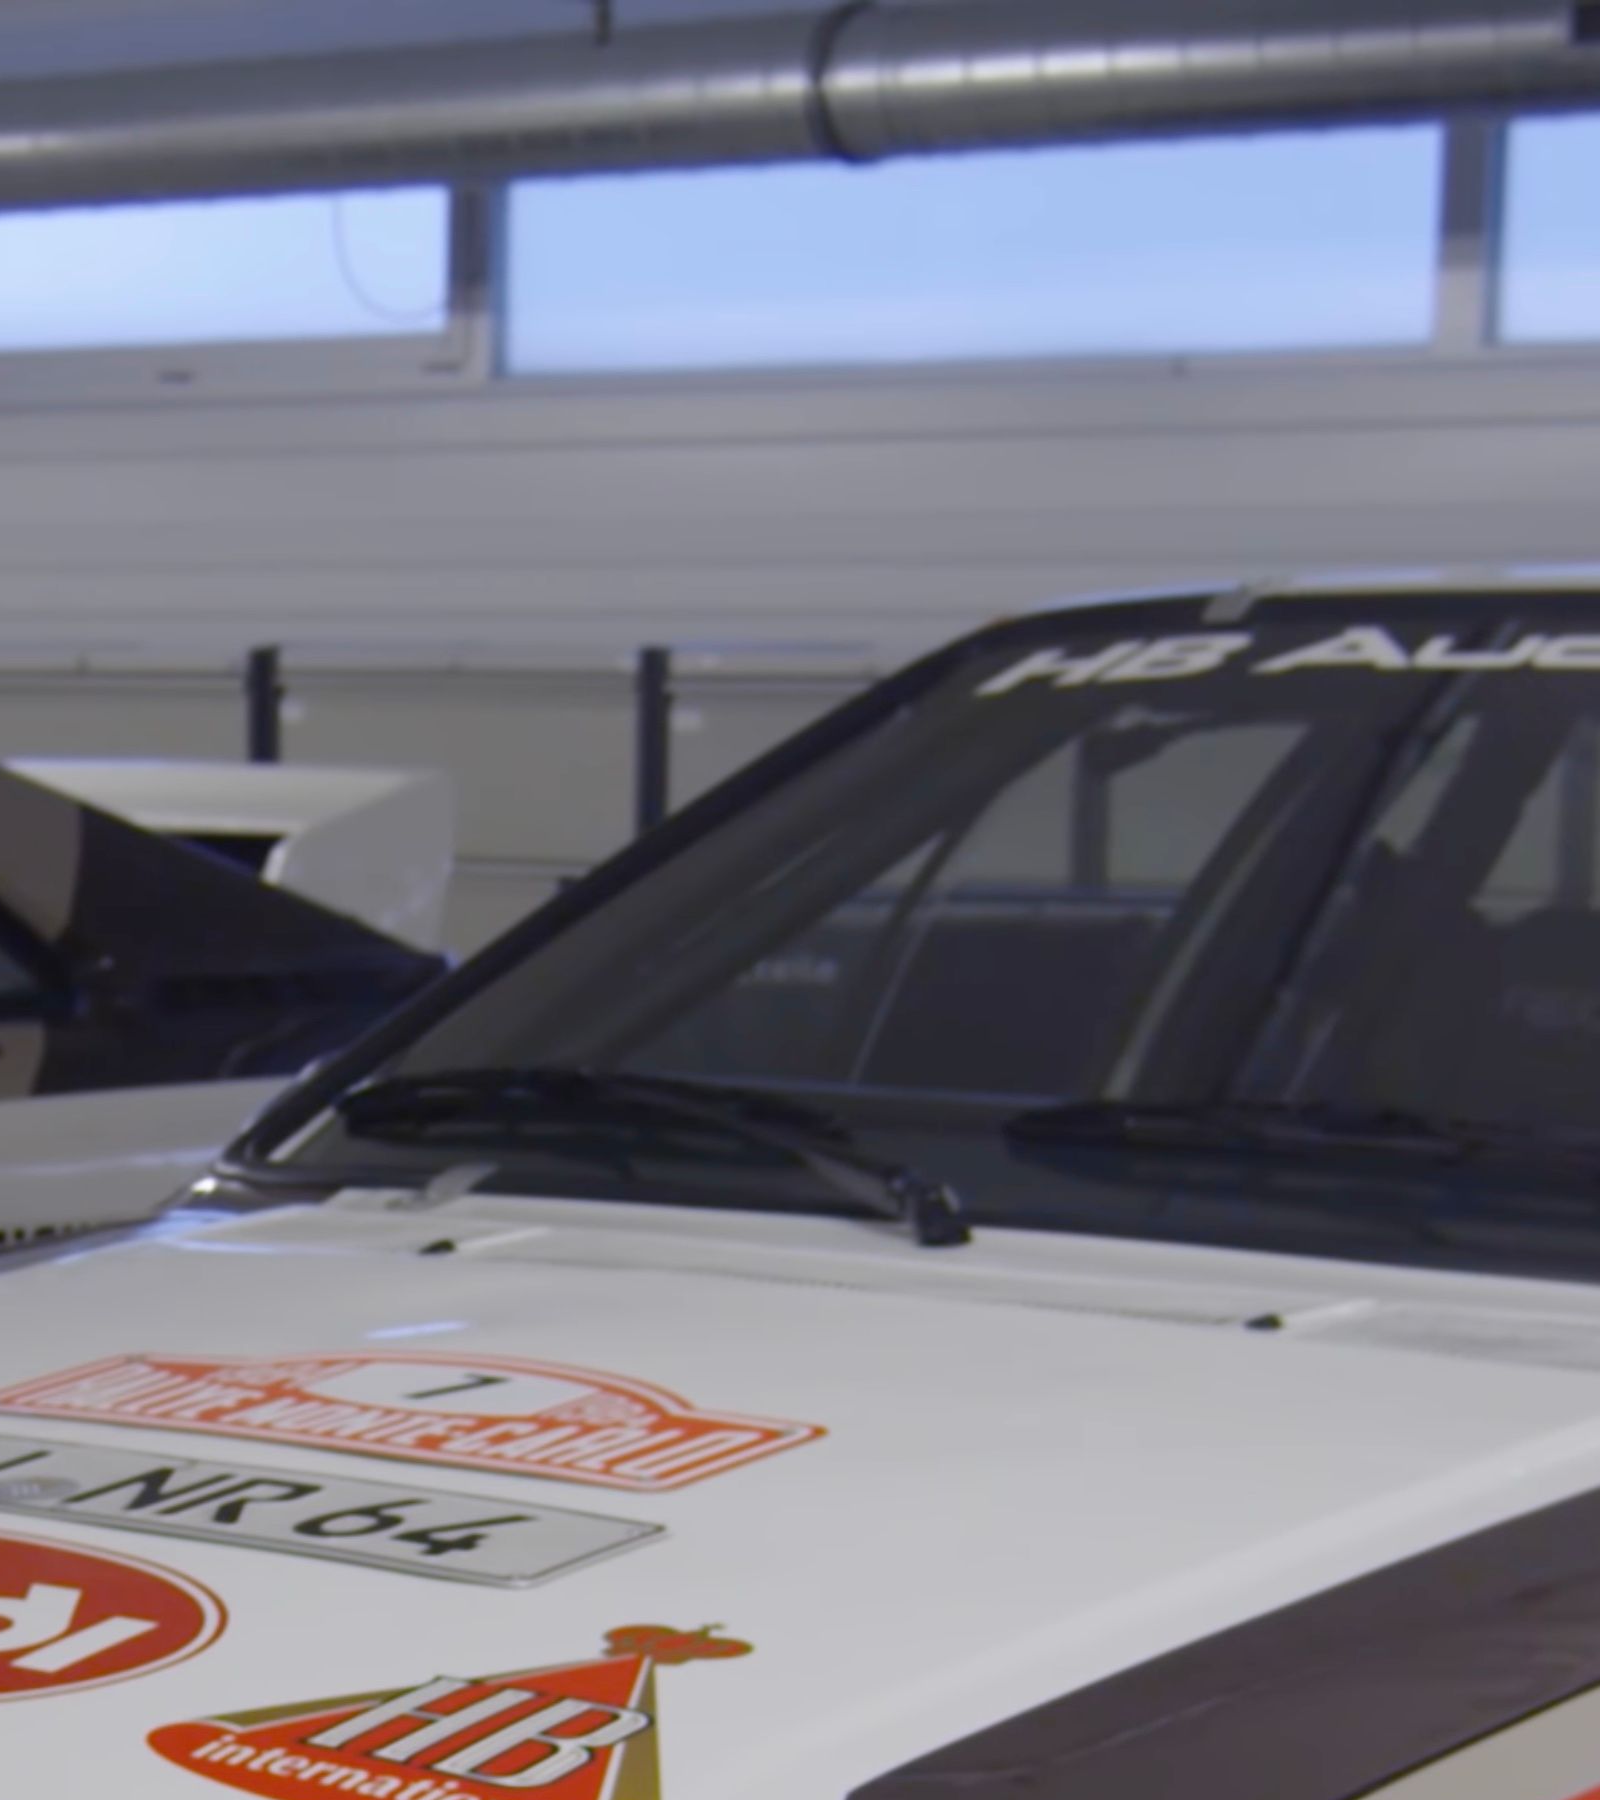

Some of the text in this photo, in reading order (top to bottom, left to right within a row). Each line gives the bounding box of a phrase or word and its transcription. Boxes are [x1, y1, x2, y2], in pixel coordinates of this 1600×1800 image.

[976, 634, 1252, 695] HB
[401, 1370, 512, 1402] 7
[63, 1466, 323, 1525] NR
[293, 1501, 542, 1557] 64
[300, 1676, 655, 1789] HB
